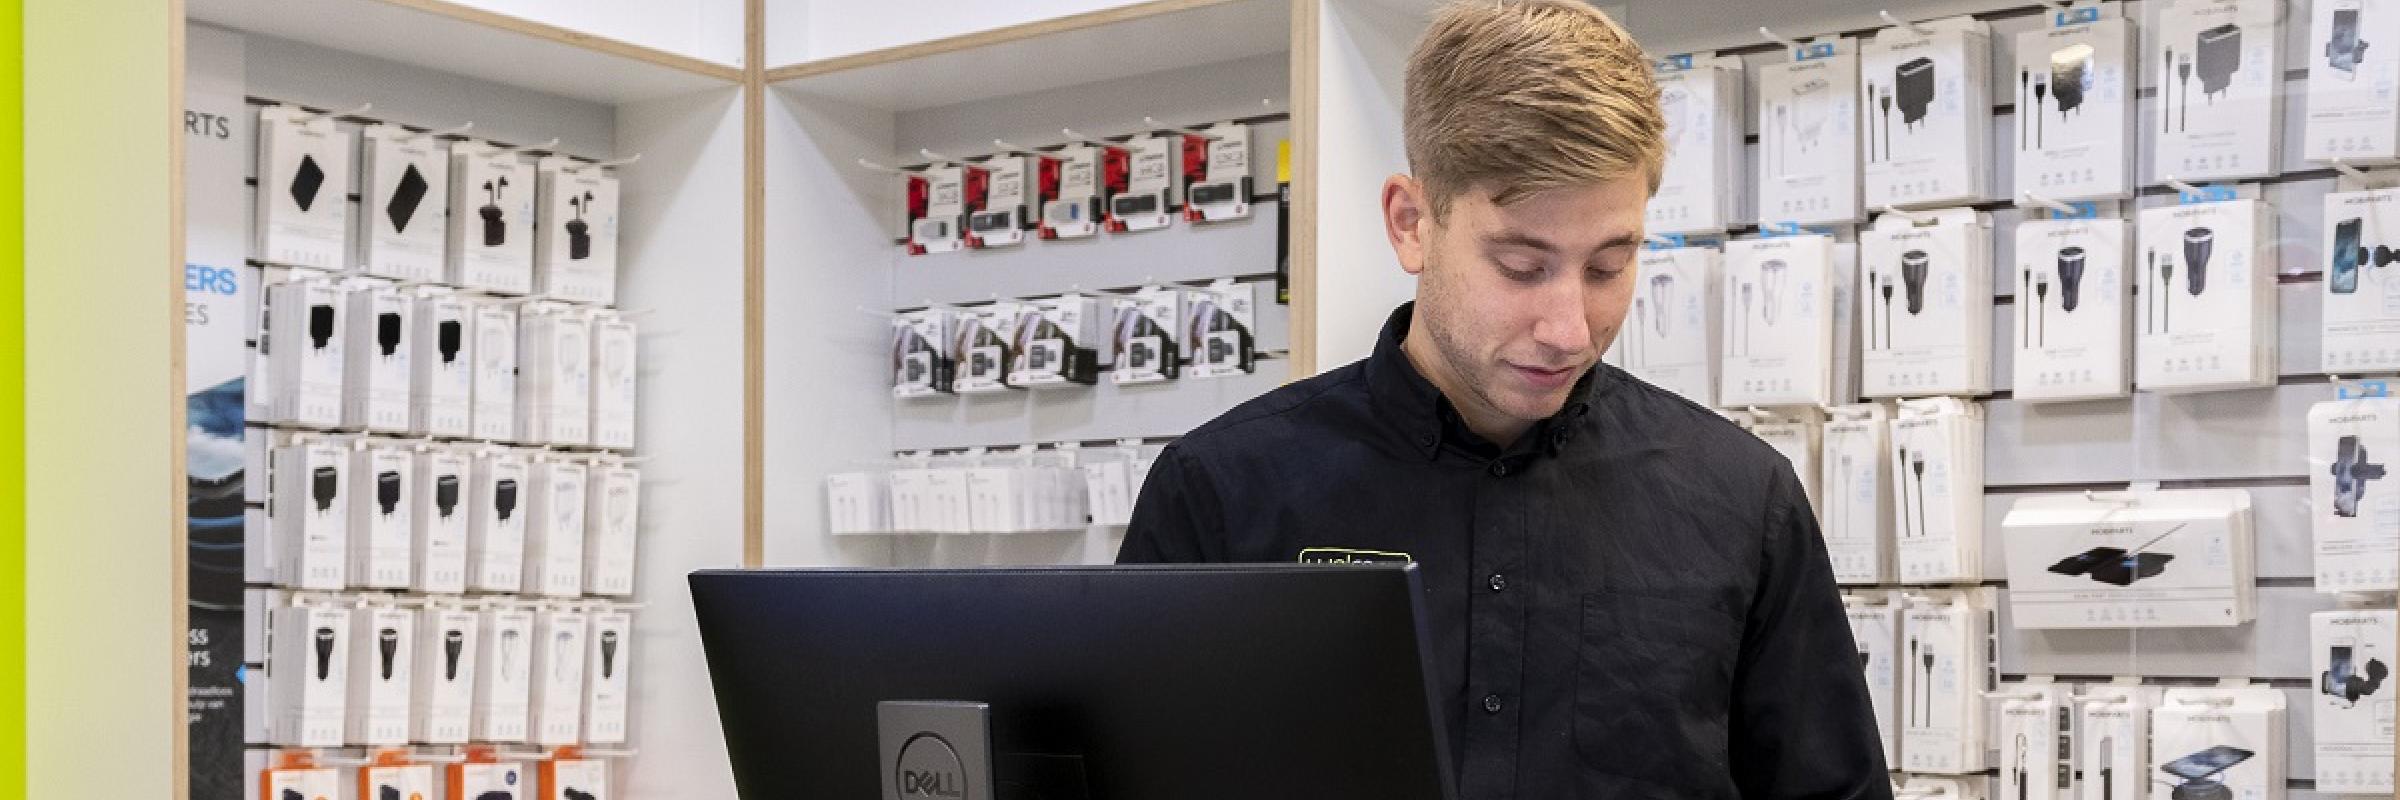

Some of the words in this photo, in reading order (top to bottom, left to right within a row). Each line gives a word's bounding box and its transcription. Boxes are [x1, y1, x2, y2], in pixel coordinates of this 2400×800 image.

[184, 111, 230, 138] RTS
[185, 264, 236, 294] ERS
[903, 771, 961, 797] DELL
